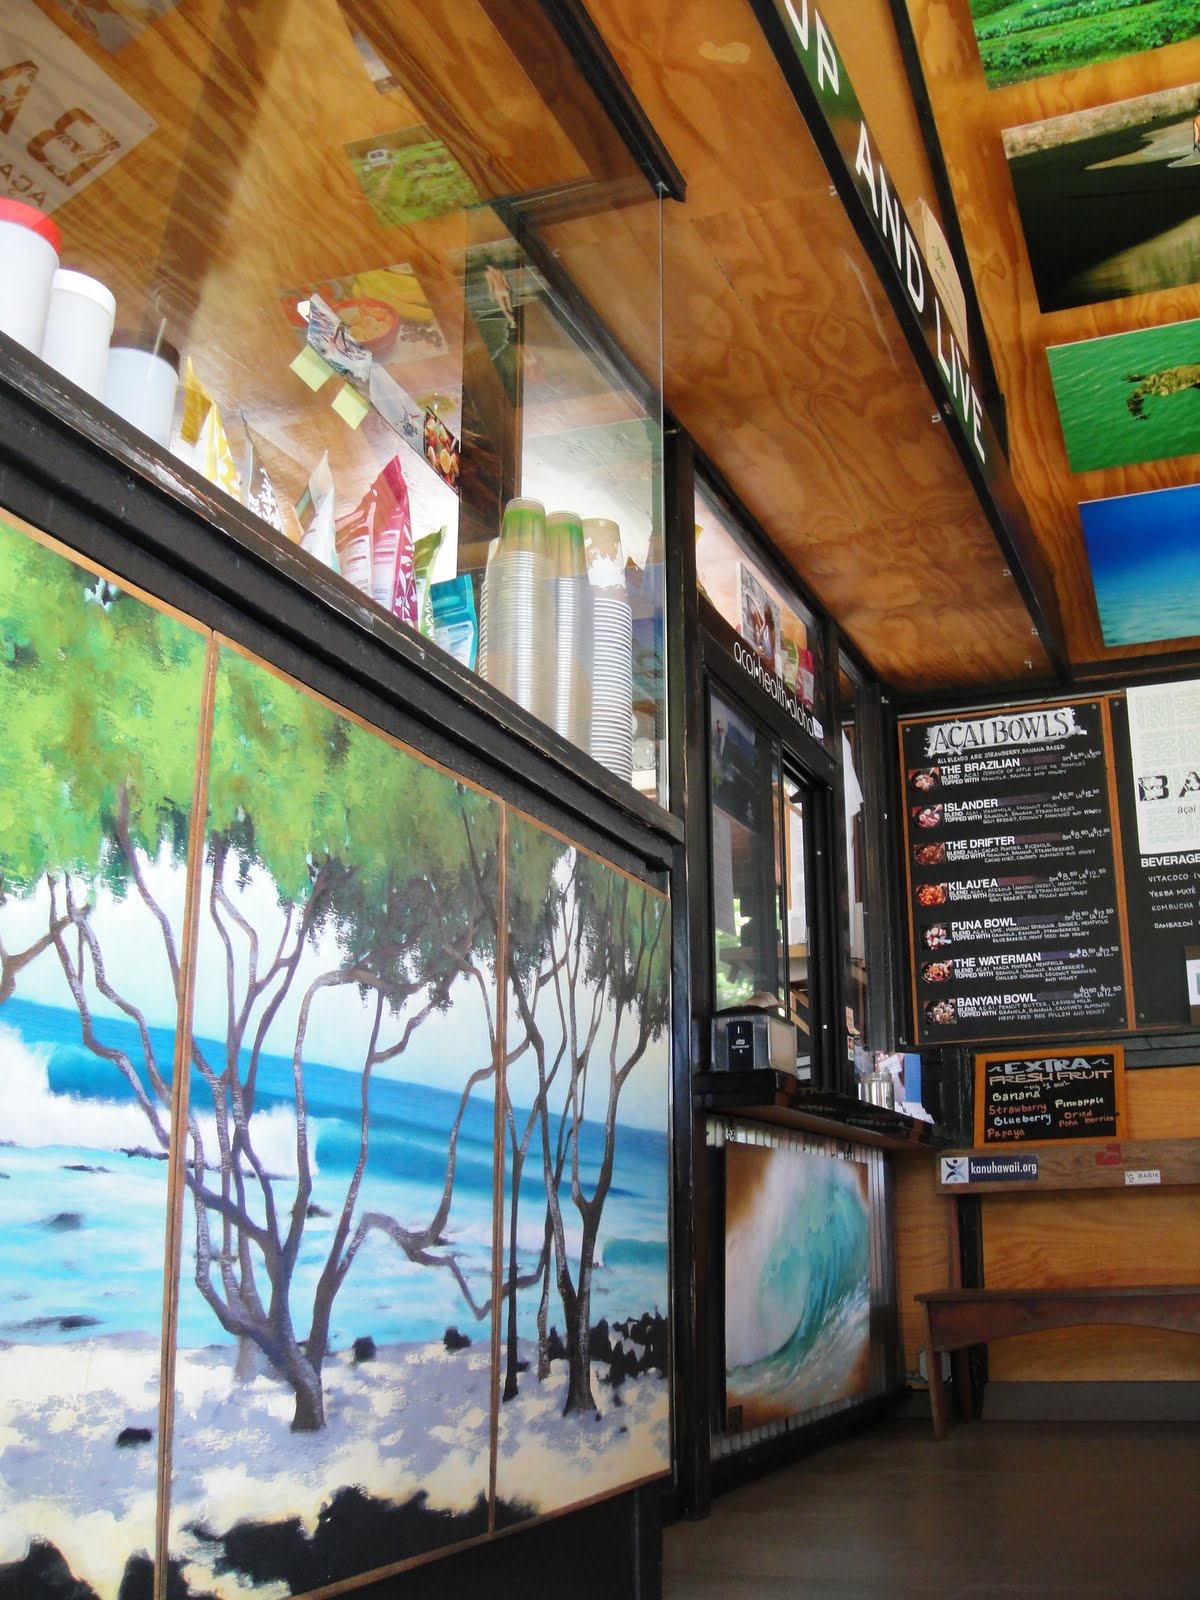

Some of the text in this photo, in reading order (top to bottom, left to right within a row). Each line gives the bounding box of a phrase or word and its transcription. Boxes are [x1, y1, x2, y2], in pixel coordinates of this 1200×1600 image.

[856, 120, 924, 313] AND
[935, 296, 985, 464] LIVE
[992, 712, 1069, 745] BOWLS
[941, 758, 1020, 774] THE BRAZILIAN
[944, 799, 998, 812] ISLANDER
[1177, 804, 1196, 815] açai
[946, 841, 967, 850] THE
[970, 836, 1015, 848] DRIFTER
[1141, 854, 1200, 868] BEVERAGE
[948, 878, 998, 891] KILAU'EA
[1148, 873, 1189, 883] VITACOCO
[1149, 889, 1174, 898] YERBA
[1152, 902, 1194, 912] KOMBUCHA
[952, 920, 982, 930] PUNA
[984, 917, 1016, 928] BOWL
[1154, 920, 1193, 929] SAMBAZON
[954, 958, 976, 968] THE
[979, 952, 1041, 966] WATERMAN
[957, 995, 1002, 1007] BANYAN
[1004, 993, 1037, 1004] BOWL
[1004, 1058, 1092, 1075] EXTRA
[989, 1069, 1113, 1086] FRESH FRUIT
[992, 1091, 1040, 1102] Banana
[1055, 1096, 1104, 1109] Pineapple
[988, 1103, 1047, 1116] Strawberry
[993, 1113, 1052, 1126] Blueberry
[987, 1128, 1025, 1139] Papaya
[970, 1161, 1037, 1175] kanuhawaii.org
